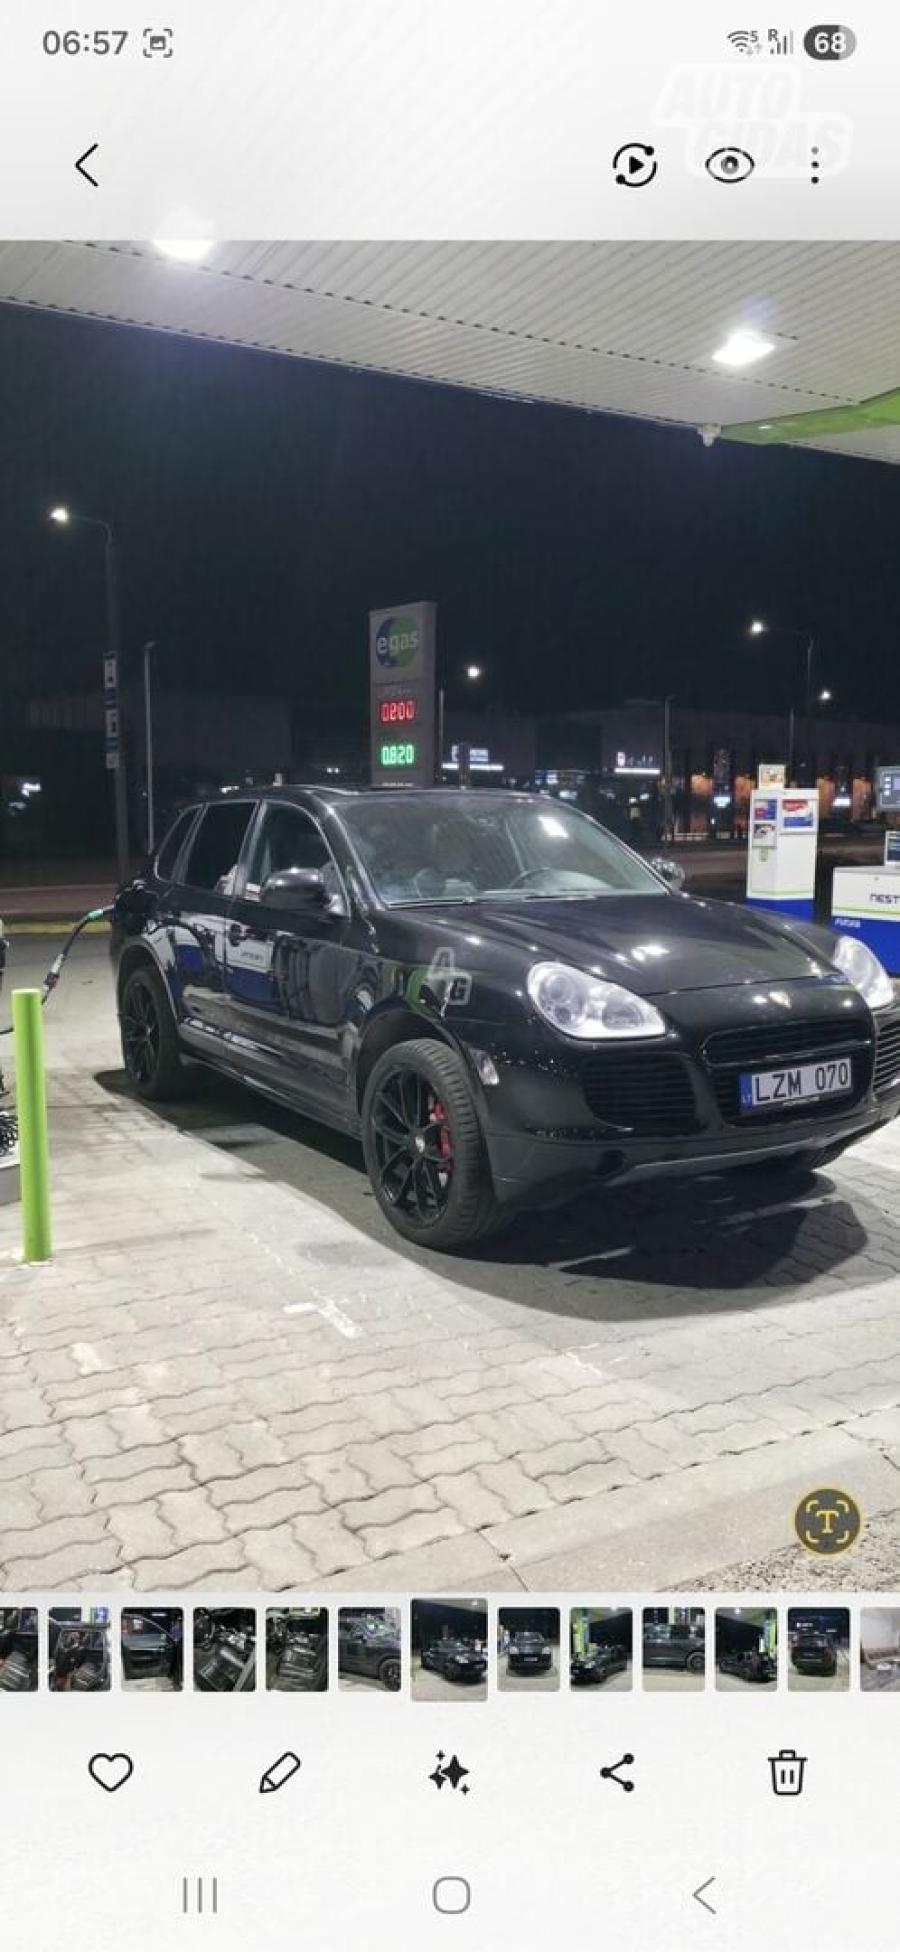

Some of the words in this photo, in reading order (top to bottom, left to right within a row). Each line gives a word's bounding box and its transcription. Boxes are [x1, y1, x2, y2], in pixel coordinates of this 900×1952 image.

[42, 30, 129, 55] 06:57
[767, 28, 779, 42] R
[814, 31, 848, 53] 68
[377, 631, 419, 657] egas
[756, 1069, 802, 1102] LZM
[815, 1062, 849, 1090] 070
